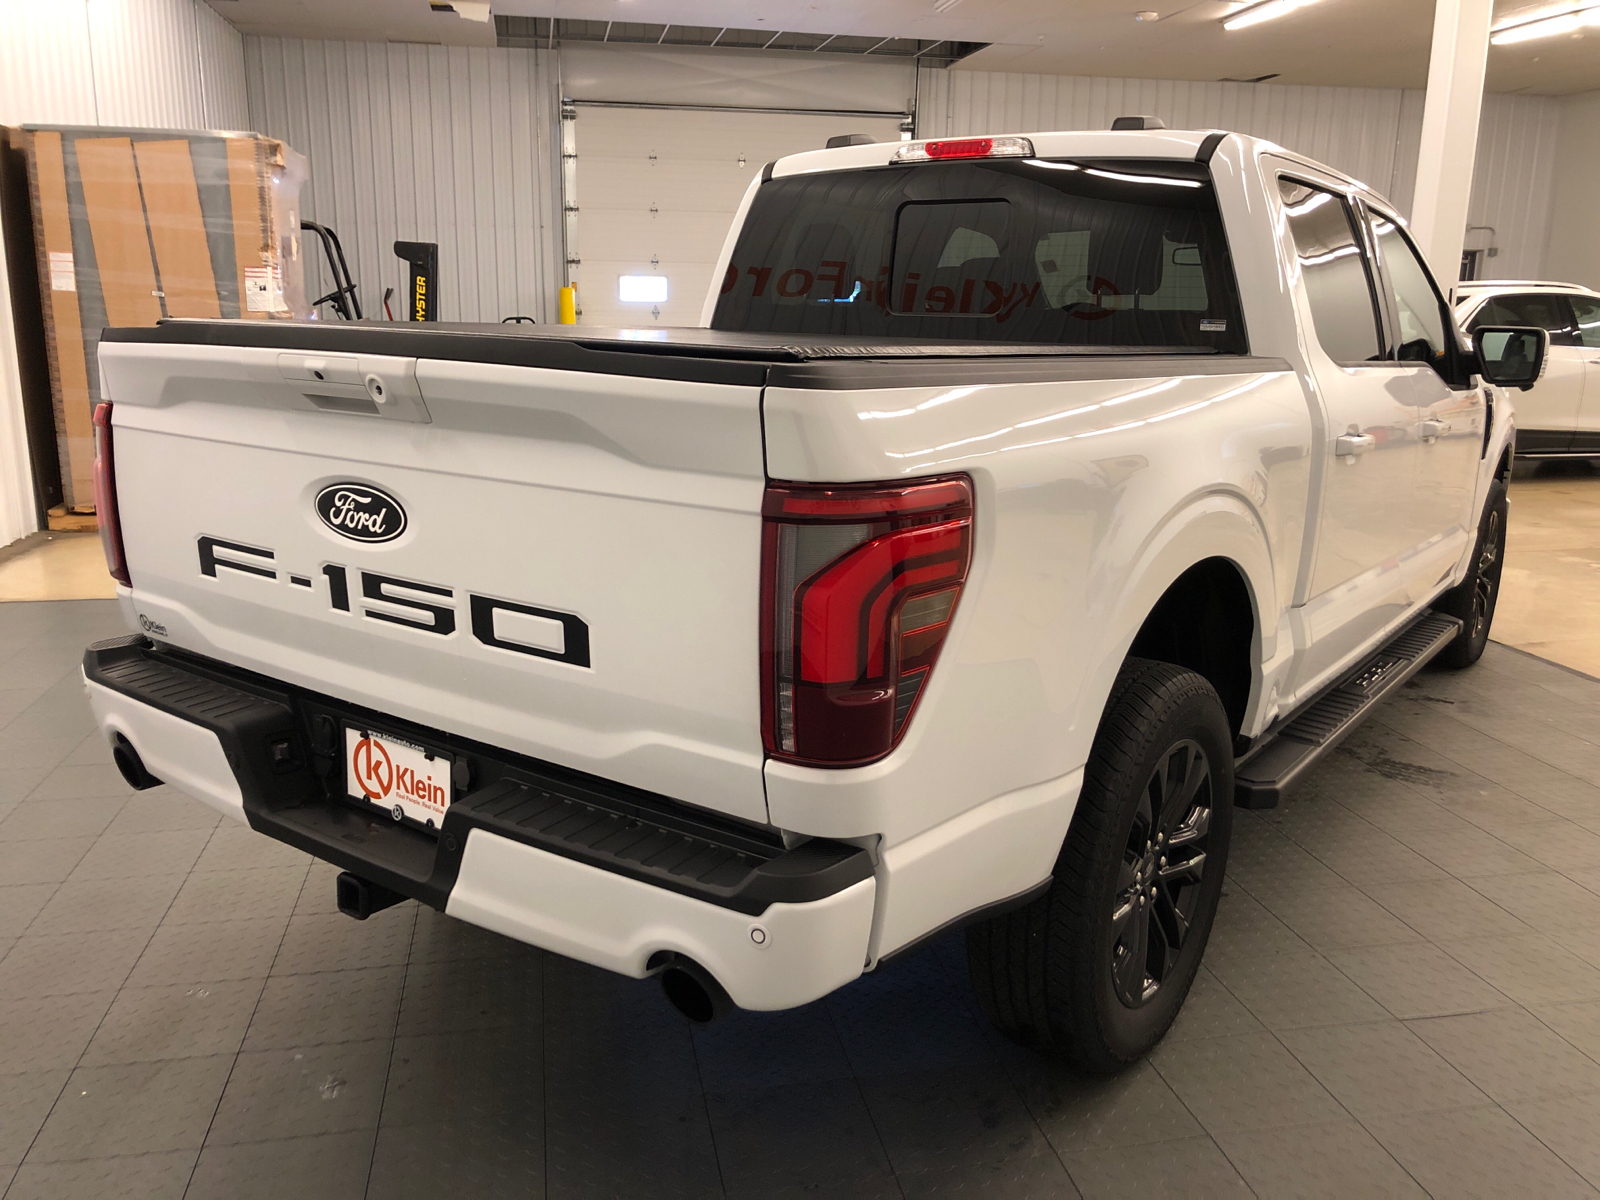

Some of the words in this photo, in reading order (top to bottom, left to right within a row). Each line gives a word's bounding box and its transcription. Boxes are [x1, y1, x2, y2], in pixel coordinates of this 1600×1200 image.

[329, 490, 388, 534] Ford
[197, 536, 592, 669] F-150
[396, 764, 445, 807] Klein
[396, 791, 405, 799] Real
[422, 801, 431, 810] Real
[432, 805, 445, 815] Value
